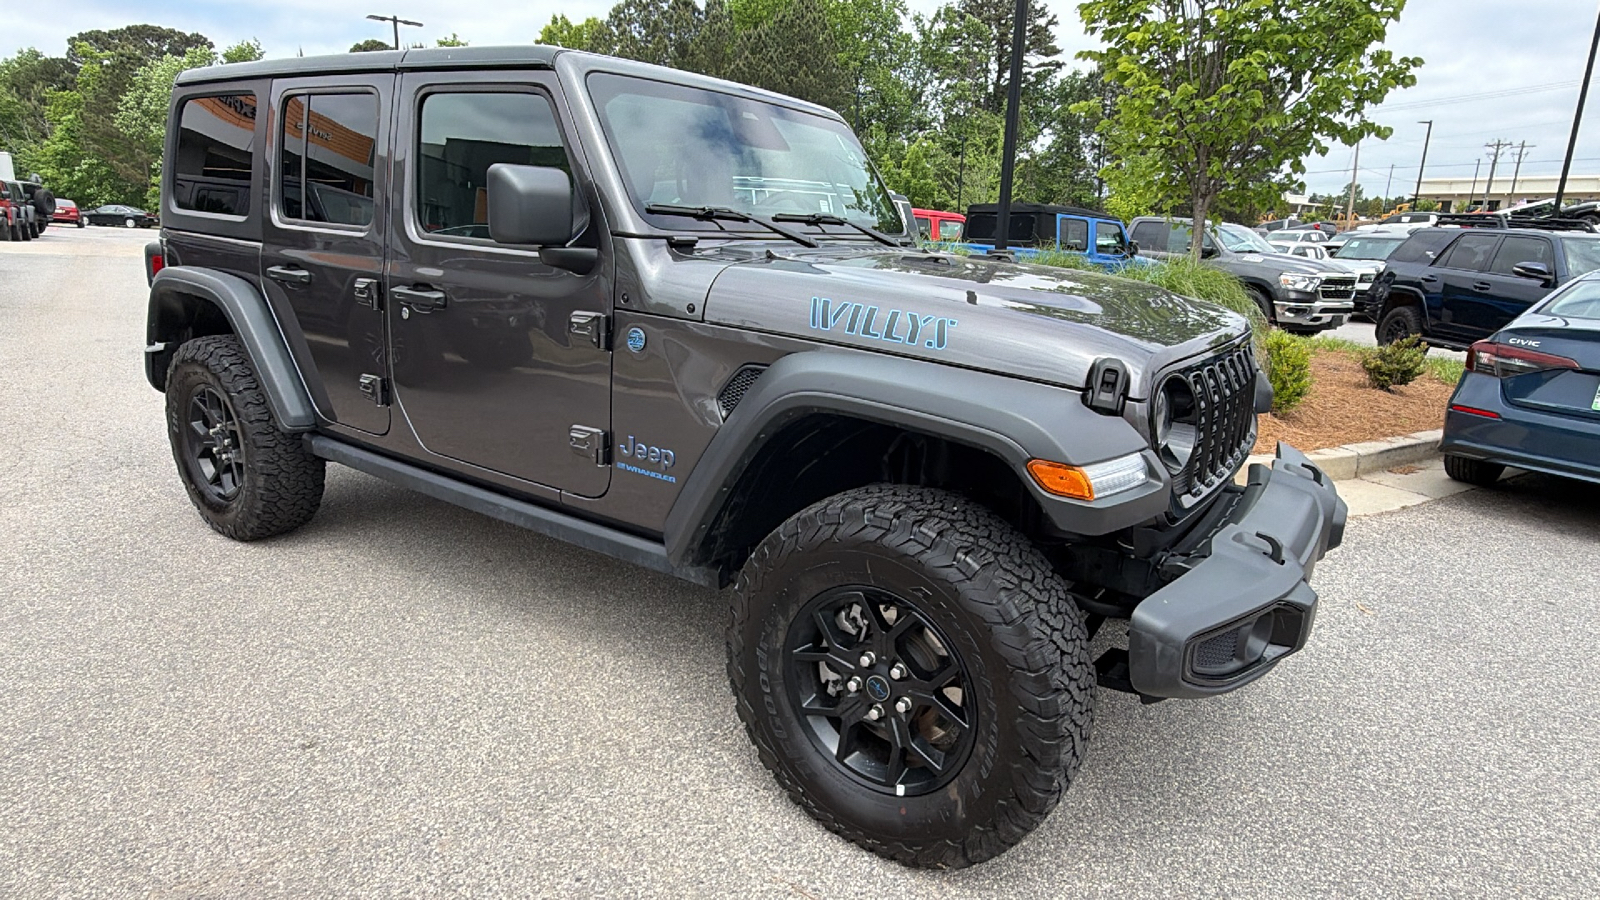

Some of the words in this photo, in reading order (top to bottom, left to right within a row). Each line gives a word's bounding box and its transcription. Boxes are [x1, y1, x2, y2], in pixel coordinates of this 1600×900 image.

[809, 296, 958, 351] WILLYS
[1508, 337, 1541, 348] CIVIC
[619, 435, 676, 471] Jeep
[755, 600, 812, 782] BFGoodri
